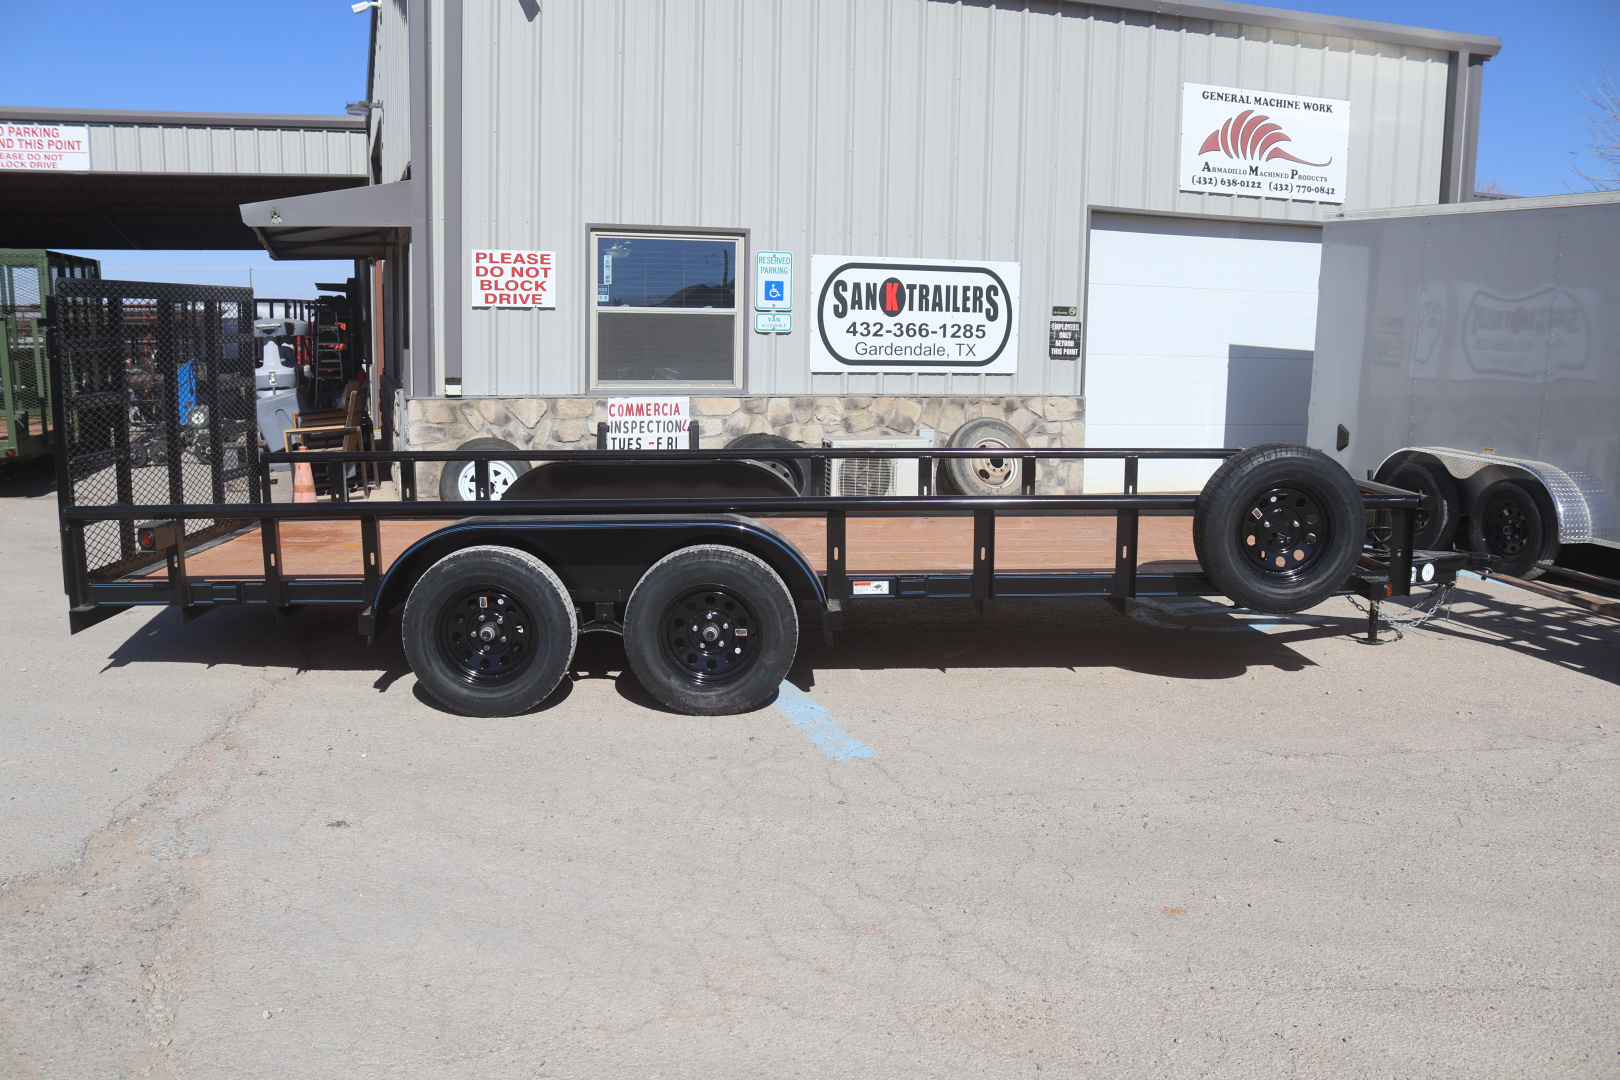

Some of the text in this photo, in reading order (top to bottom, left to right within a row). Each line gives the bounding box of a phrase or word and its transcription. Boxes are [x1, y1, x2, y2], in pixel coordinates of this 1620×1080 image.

[1202, 90, 1333, 113] GENERAL MACHINE WORK
[8, 126, 60, 138] PARKING
[18, 139, 44, 150] THIS
[48, 140, 82, 150] POINT
[1202, 162, 1328, 182] ARMADILLO MACHINED PRODUCTS
[1191, 175, 1336, 195] (432) 638-0122 (432) 770-0842
[476, 252, 551, 265] PLEASE
[759, 256, 790, 265] RESERVED
[476, 266, 551, 278] DO NOT
[480, 280, 547, 291] BLOCK
[484, 293, 543, 304] DRIVE
[846, 321, 987, 339] 432-366-1285
[855, 341, 977, 359] Gardendale, TX
[608, 403, 680, 417] COMMERCIA
[611, 437, 642, 450] TUES
